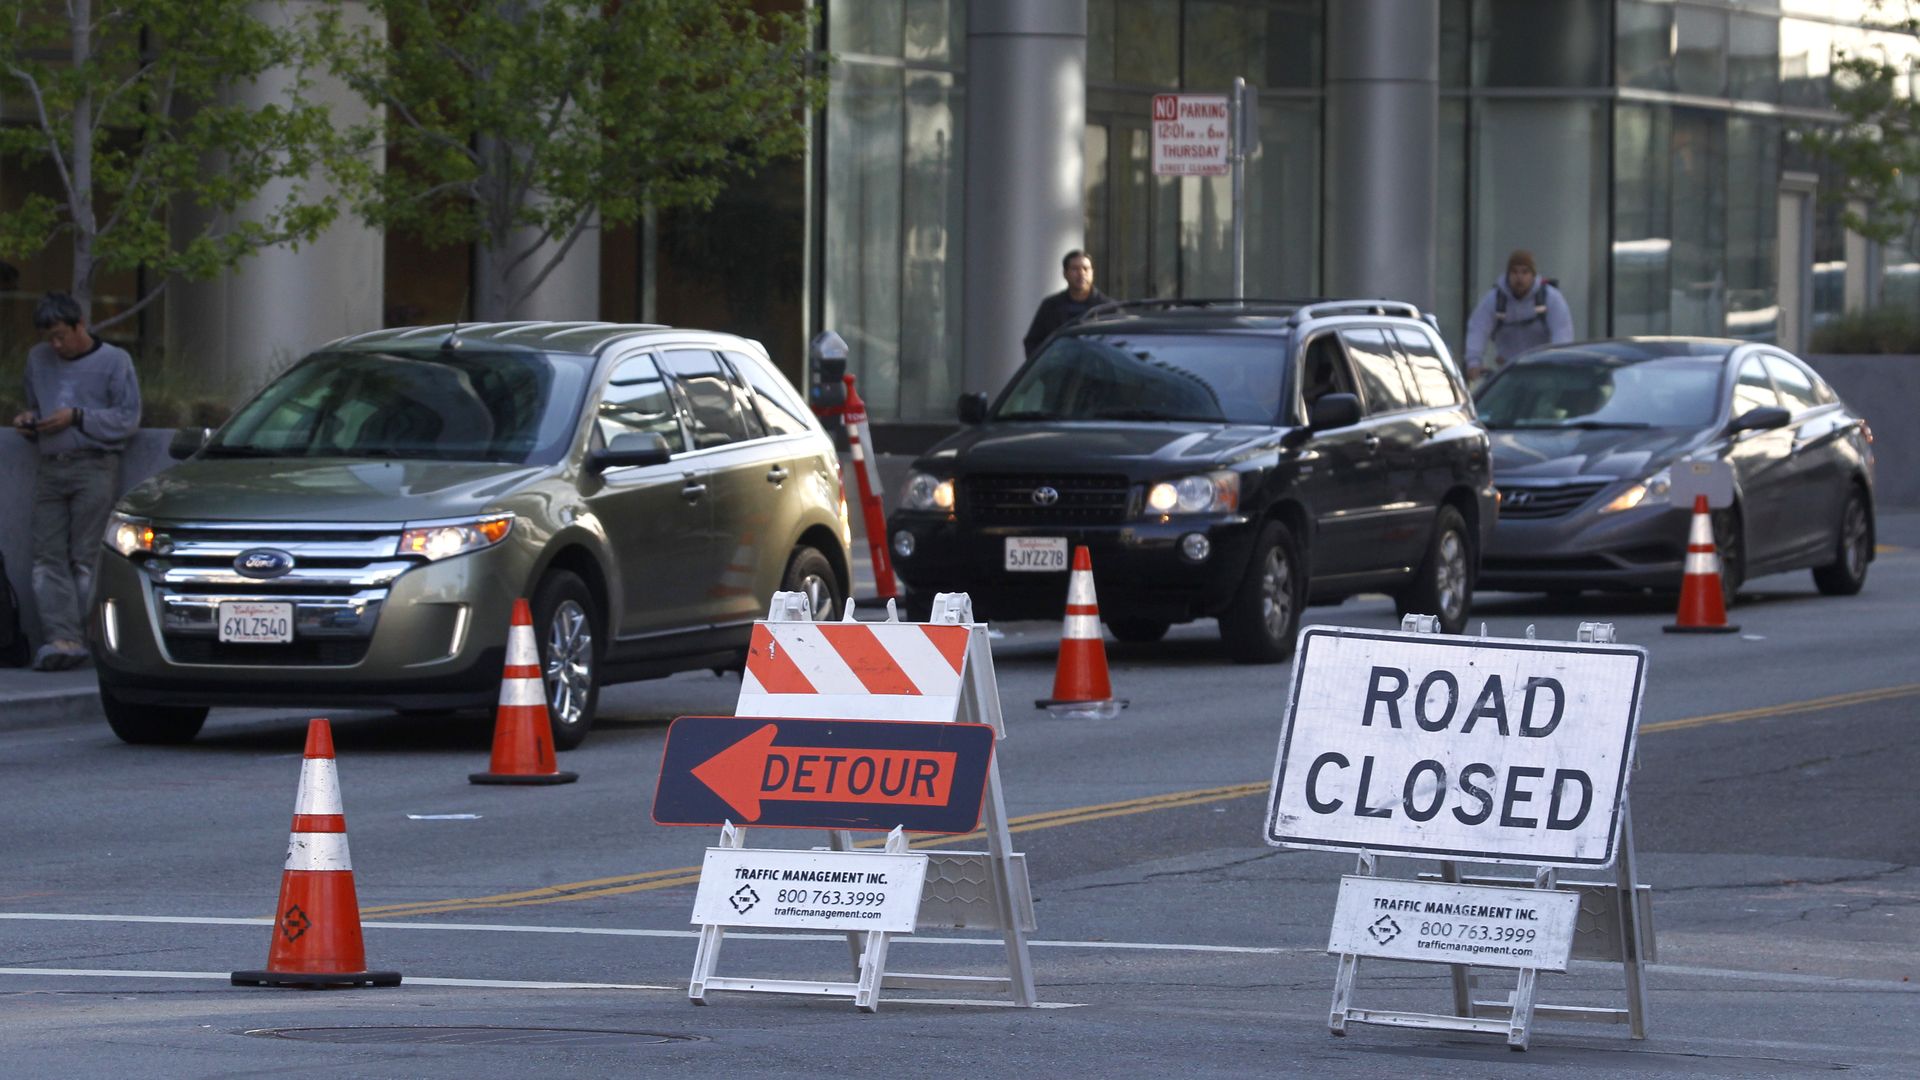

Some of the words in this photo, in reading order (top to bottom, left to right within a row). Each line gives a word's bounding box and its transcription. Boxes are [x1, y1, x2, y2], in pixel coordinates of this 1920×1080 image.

[1156, 97, 1175, 118] NO
[1180, 103, 1226, 118] PARKING
[1163, 144, 1220, 158] THURSDAY
[246, 554, 277, 568] Ford
[1010, 549, 1064, 566] 5JYZ278
[224, 617, 287, 637] 6XLZ540
[1361, 666, 1565, 738] ROAD
[760, 754, 940, 798] DETOUR
[1305, 752, 1593, 831] CLOSED
[735, 868, 780, 880] TRAFFIC
[782, 870, 864, 883] MANAGEMENT
[866, 873, 888, 884] INC.
[777, 889, 807, 903] 800
[812, 890, 885, 906] 763.3999
[774, 907, 881, 919] trafficmanagement.com
[1374, 898, 1421, 912] TRAFFIC
[1424, 902, 1512, 919] MANAGEMENT
[1515, 908, 1538, 921] INC.
[1420, 921, 1452, 936] 800
[1458, 924, 1536, 943] 763.3999
[1417, 940, 1533, 956] trafficmanagement.com
